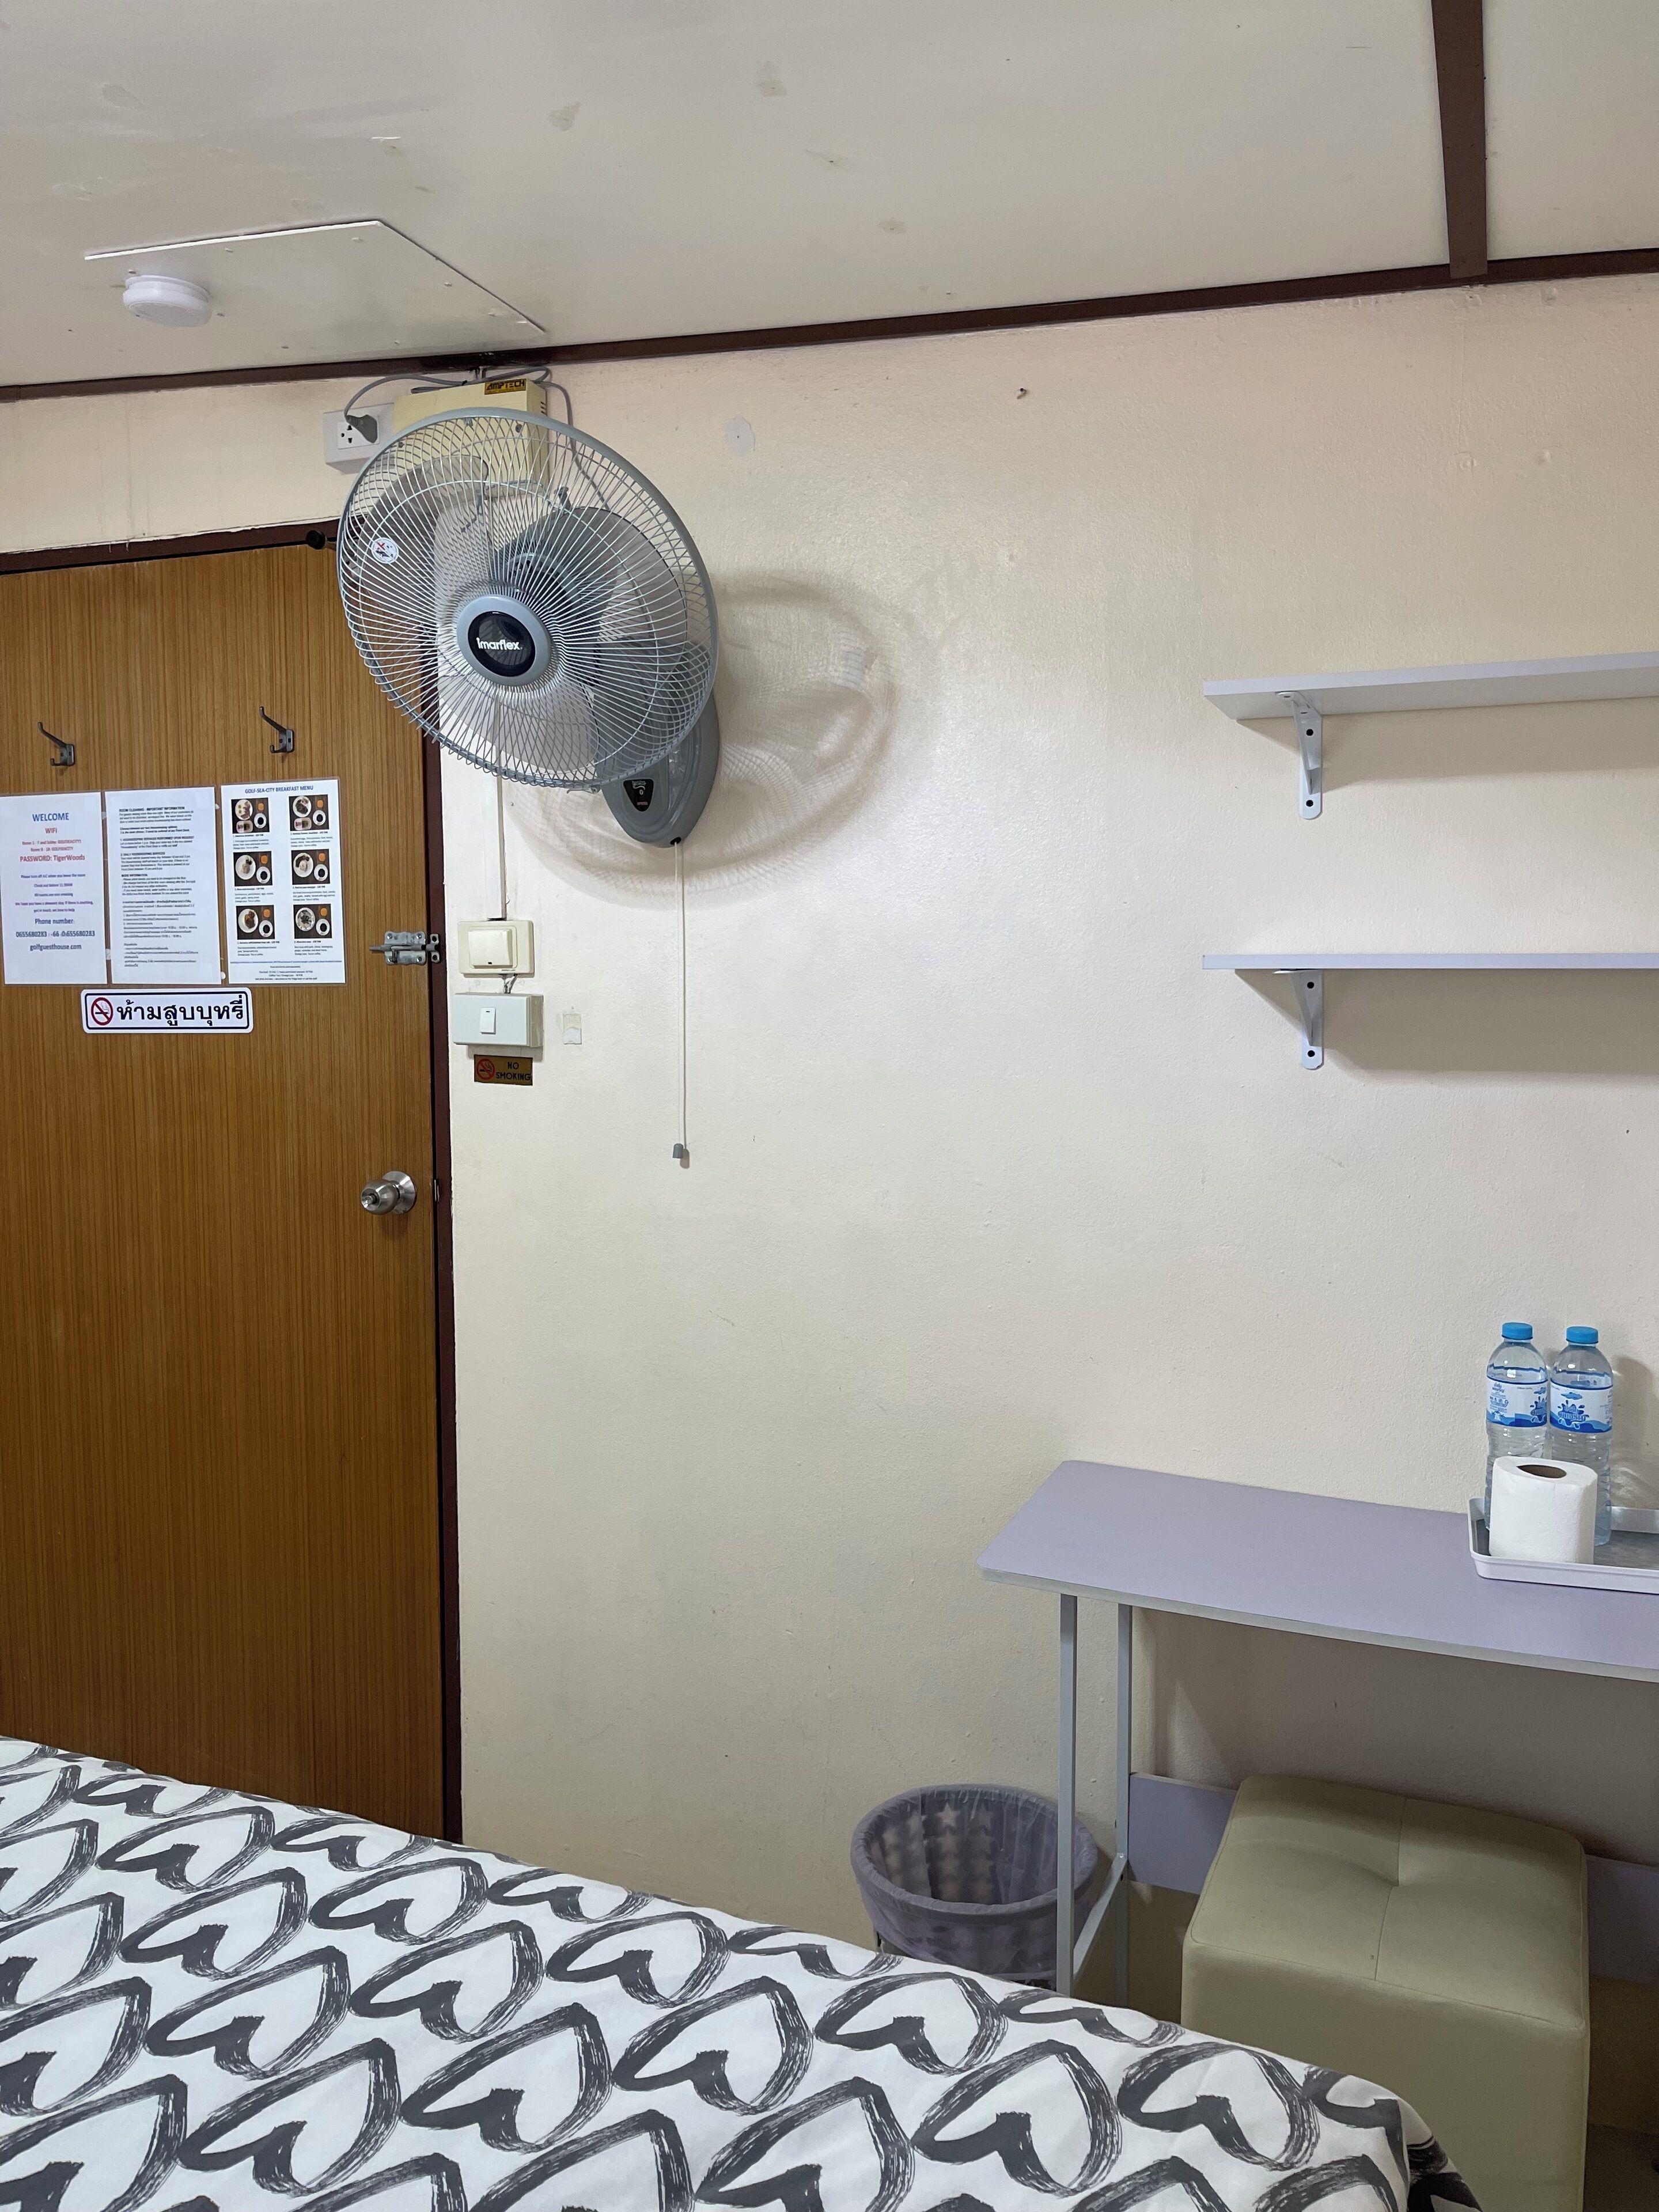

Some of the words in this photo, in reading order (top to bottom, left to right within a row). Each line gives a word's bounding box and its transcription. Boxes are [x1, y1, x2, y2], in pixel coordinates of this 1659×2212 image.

[486, 380, 525, 391] AMPTECH
[476, 637, 520, 650] imarflex
[32, 812, 69, 822] WELCOME
[54, 854, 85, 862] TigerWoods
[116, 995, 243, 1026] ห้ามสูบบุหรี่
[507, 1062, 519, 1070] NO
[496, 1072, 531, 1081] SMOKING
